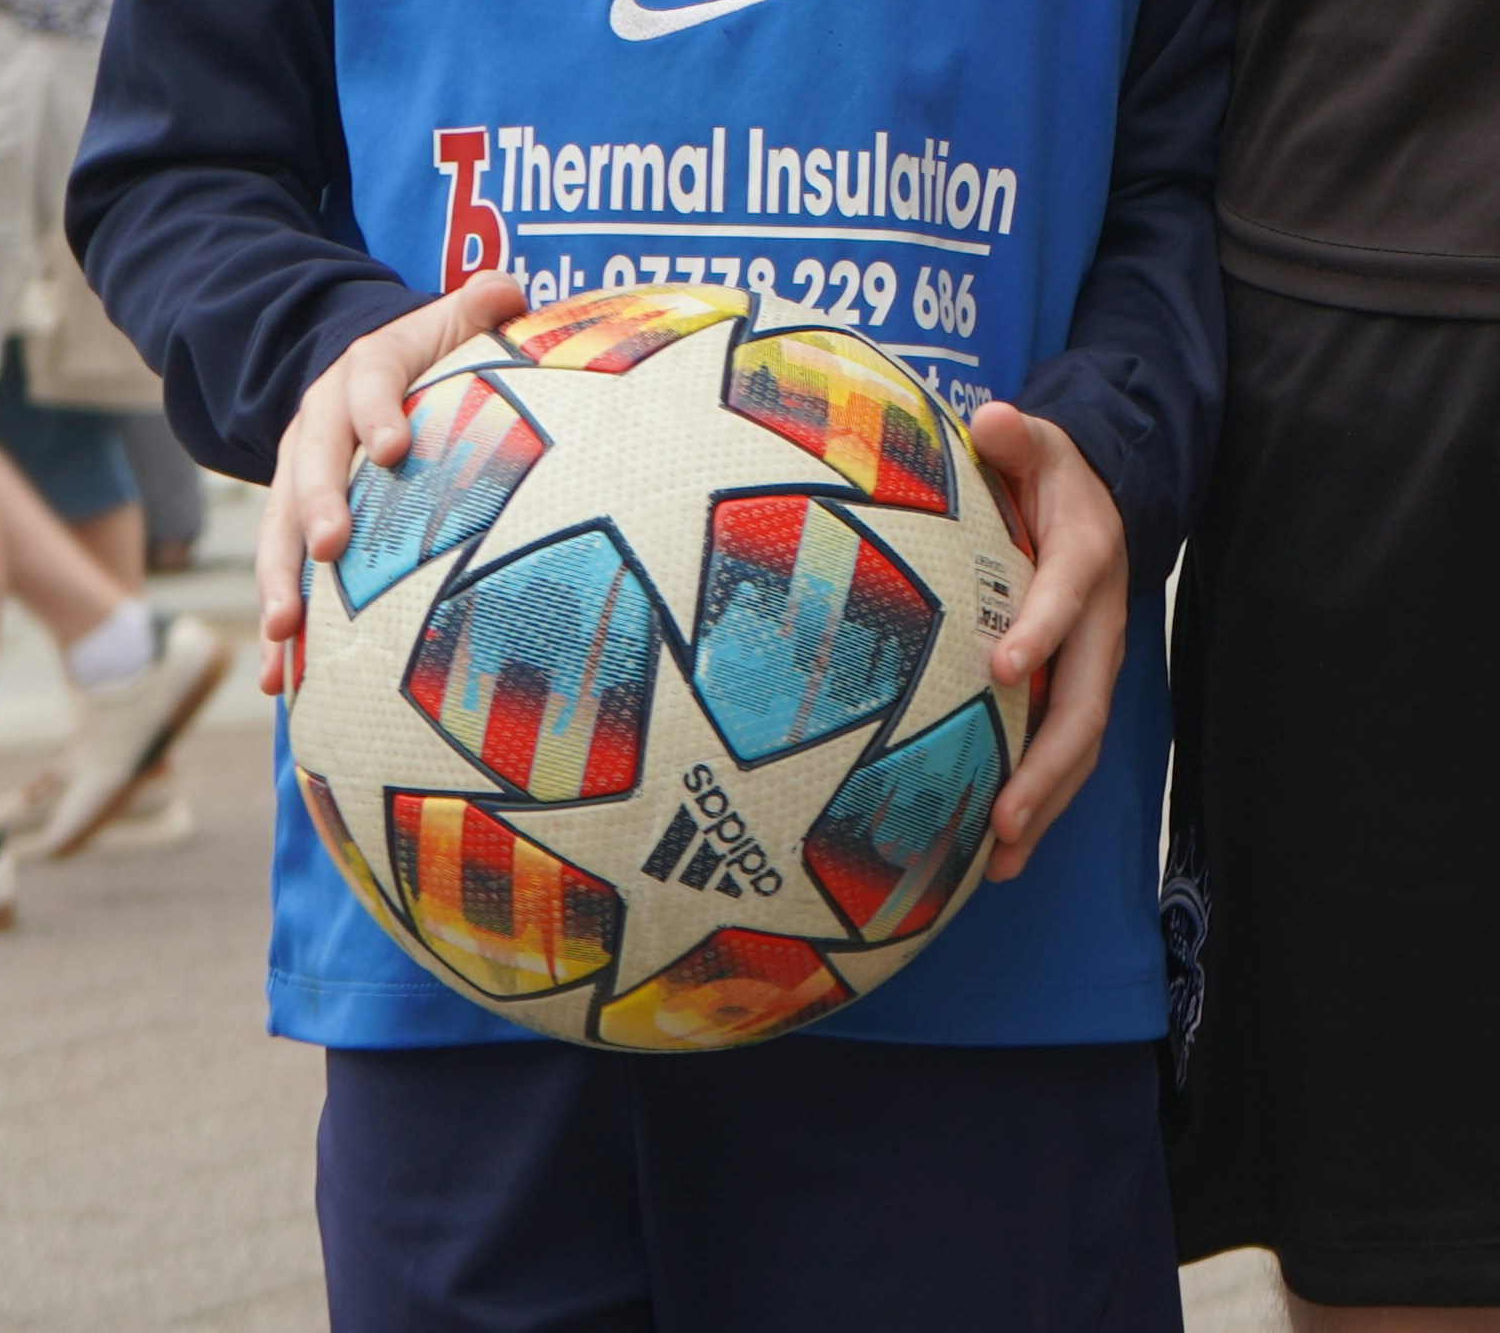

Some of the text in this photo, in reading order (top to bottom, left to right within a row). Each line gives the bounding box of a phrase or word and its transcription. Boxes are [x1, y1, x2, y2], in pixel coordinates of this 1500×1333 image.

[497, 125, 1018, 235] Thermal Insulation
[791, 258, 898, 327] 229
[911, 266, 977, 339] 686
[682, 762, 784, 898] adidas
